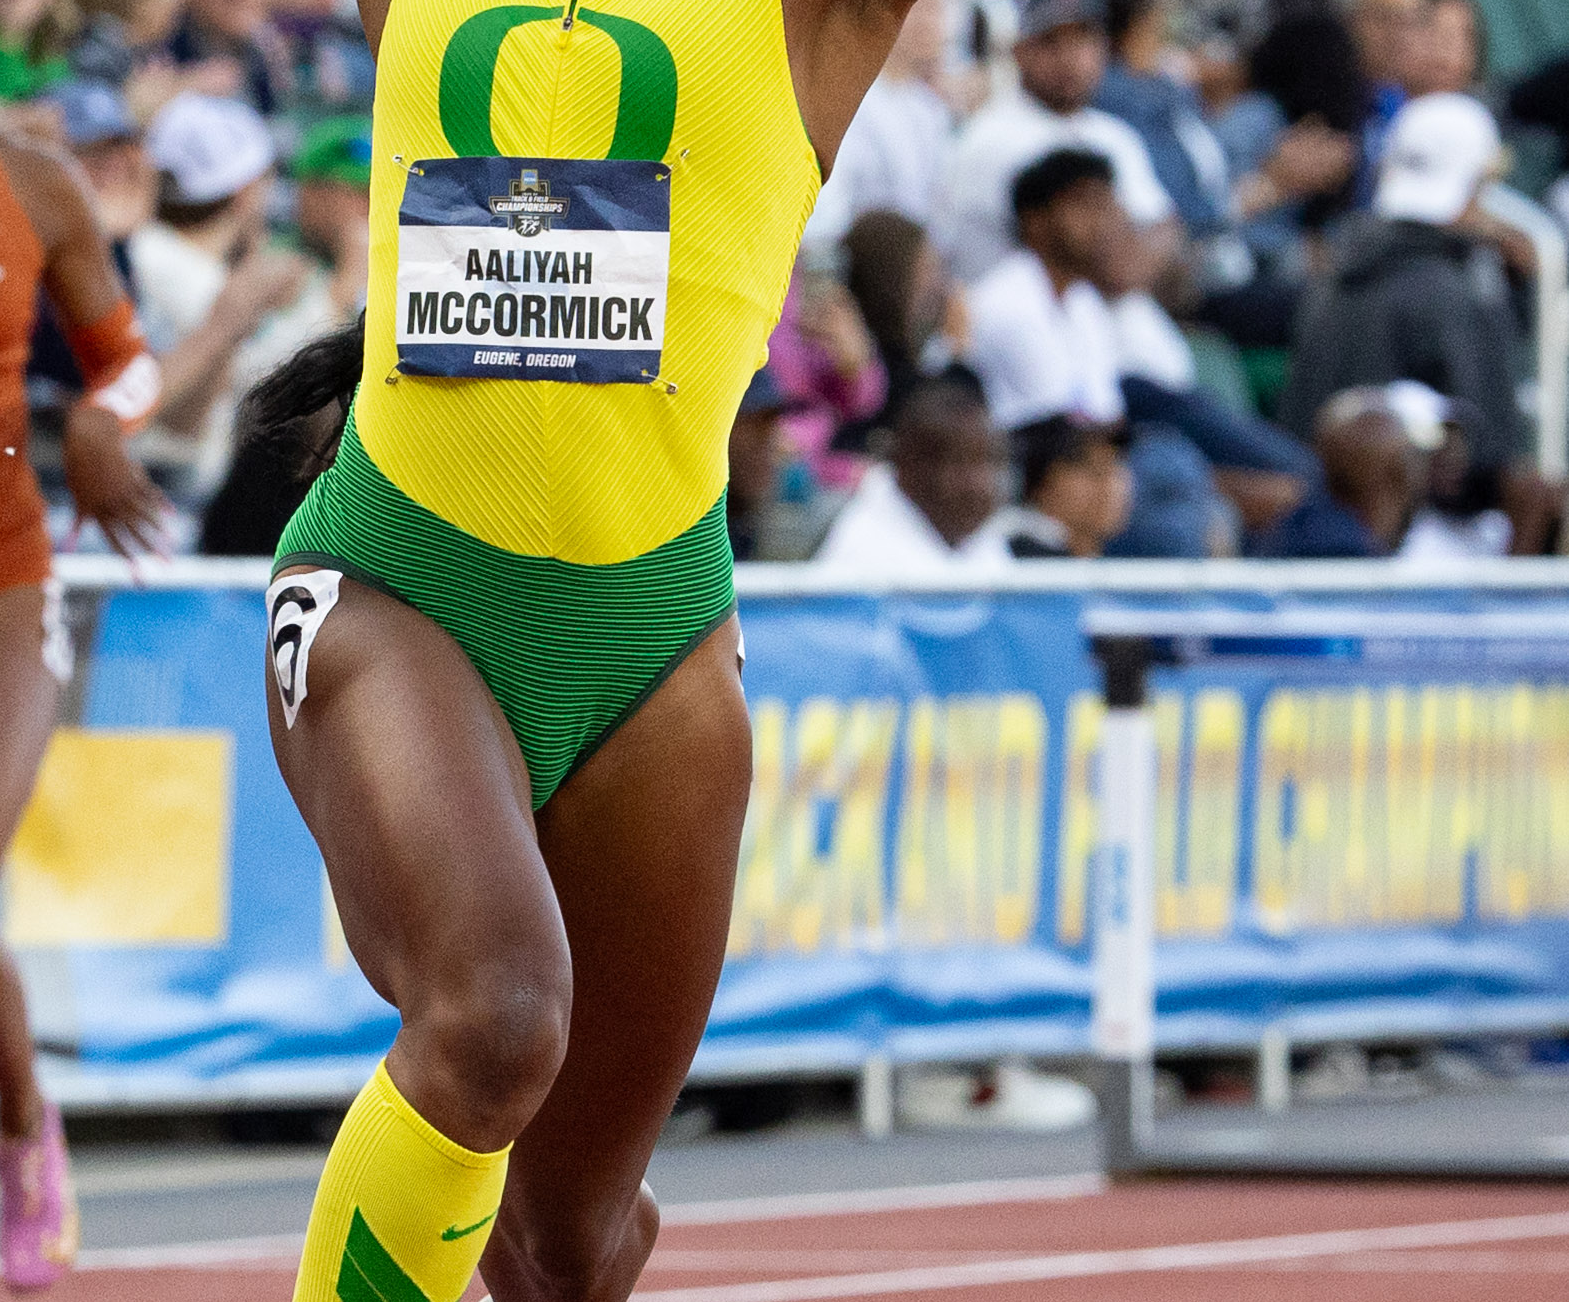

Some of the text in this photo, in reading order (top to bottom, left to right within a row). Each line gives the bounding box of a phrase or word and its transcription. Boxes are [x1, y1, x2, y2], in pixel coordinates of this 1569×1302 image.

[496, 202, 564, 213] CHAMPIONSHIPS
[465, 248, 593, 285] AALIYAH
[406, 291, 656, 341] MCCORMICK
[473, 350, 577, 369] EUGENE, OREGON
[272, 585, 318, 708] 6
